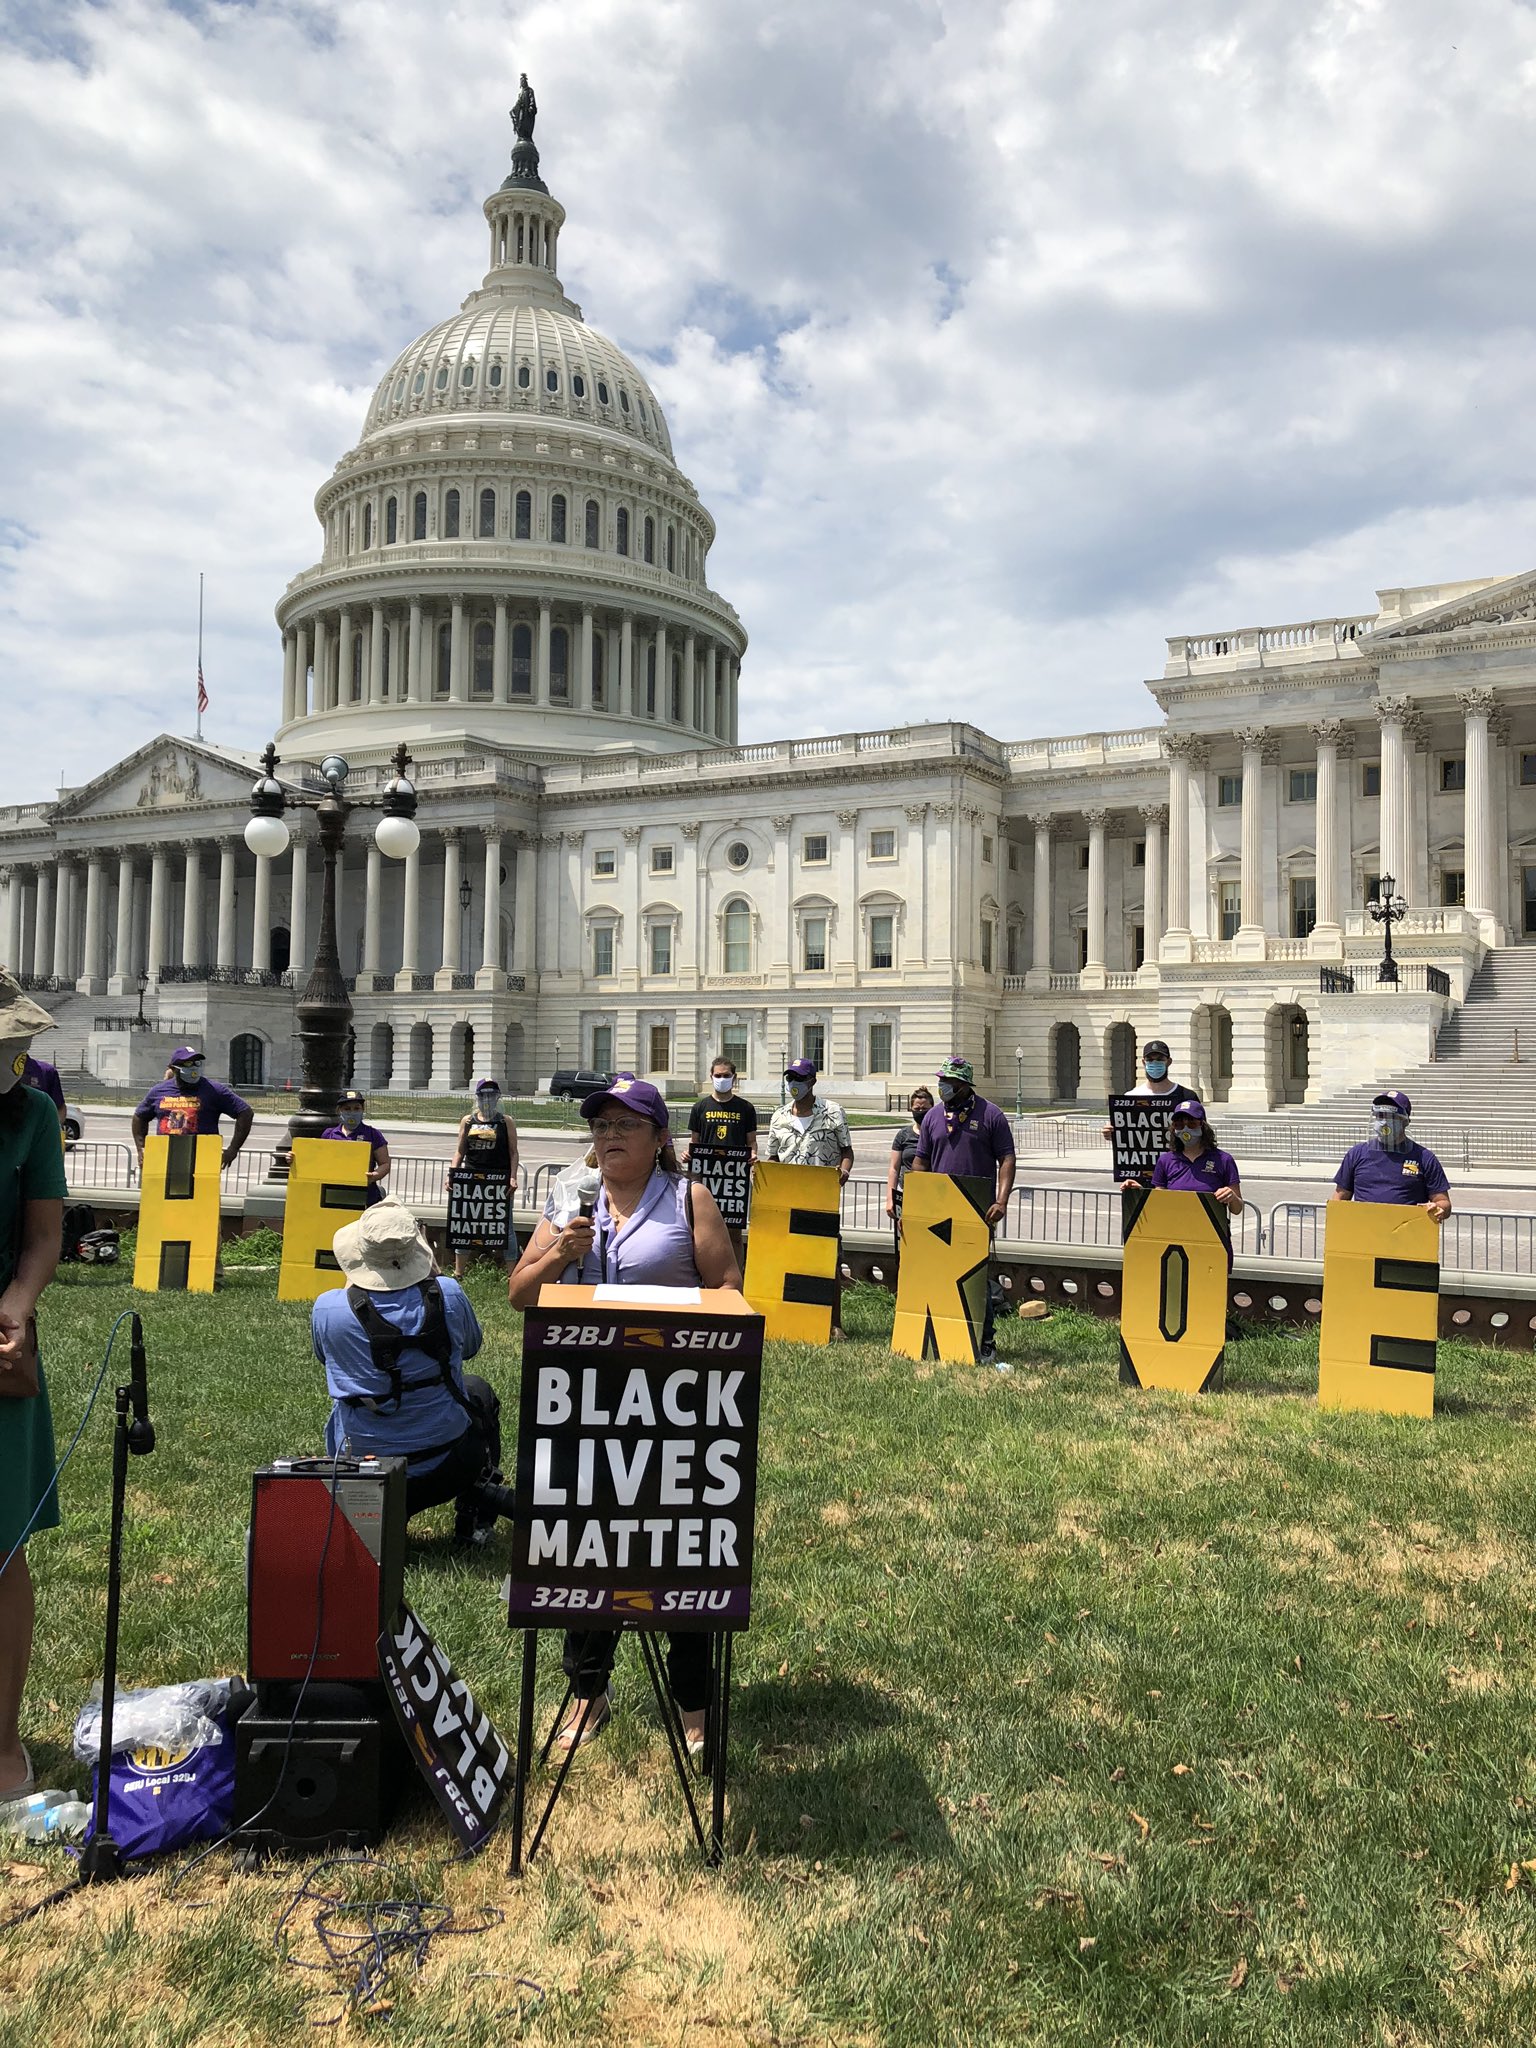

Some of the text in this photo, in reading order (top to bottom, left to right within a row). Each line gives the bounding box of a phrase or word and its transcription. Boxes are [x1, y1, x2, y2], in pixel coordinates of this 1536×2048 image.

[705, 1111, 741, 1120] SUNRISE
[469, 1141, 496, 1150] SEIU
[693, 1147, 713, 1155] 32BJ
[691, 1158, 747, 1177] BLACK
[1117, 1151, 1159, 1165] MATT
[452, 1183, 507, 1200] BLACK
[702, 1177, 746, 1198] IVES
[133, 1134, 223, 1293] H
[451, 1201, 507, 1220] LIVES
[450, 1221, 506, 1235] MATTER
[743, 1162, 841, 1345] E
[1319, 1199, 1440, 1419] E
[542, 1325, 743, 1350] 32BJ SEIU
[536, 1367, 745, 1427] BLACK
[532, 1438, 741, 1506] LIVES
[528, 1518, 739, 1568] MATTER
[531, 1587, 732, 1611] 32BJ SEIU
[394, 1614, 496, 1814] BLACK
[385, 1655, 480, 1831] 32BJ SEIU
[145, 1775, 171, 1787] Local
